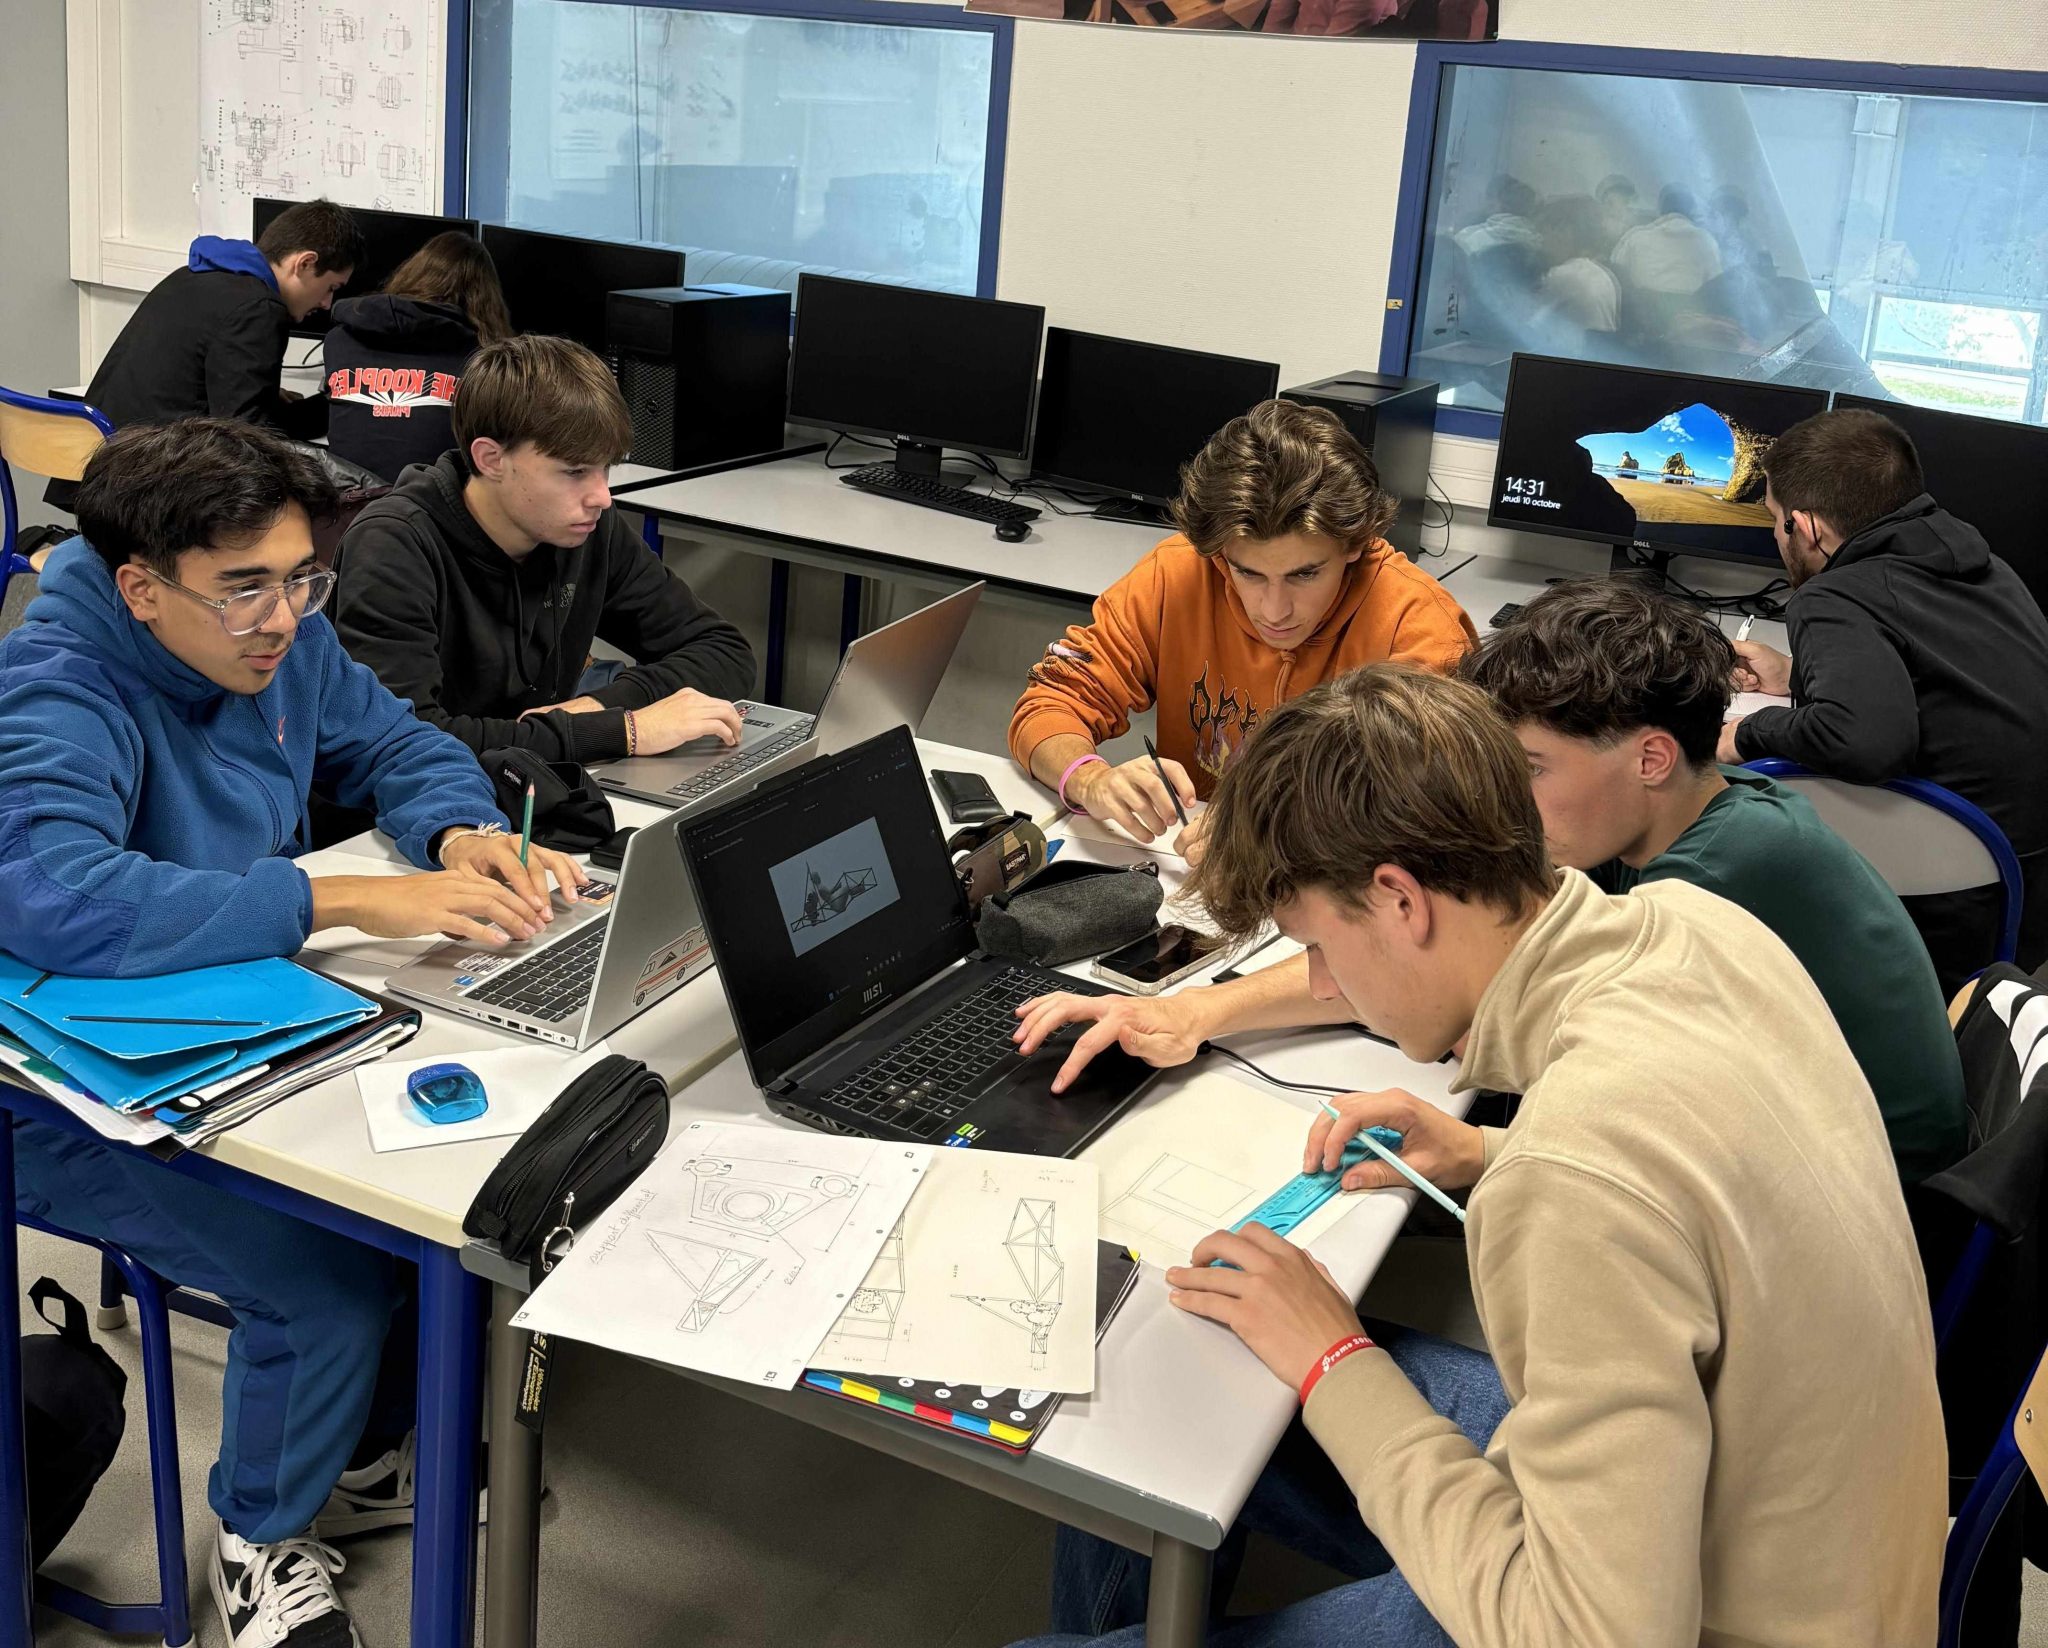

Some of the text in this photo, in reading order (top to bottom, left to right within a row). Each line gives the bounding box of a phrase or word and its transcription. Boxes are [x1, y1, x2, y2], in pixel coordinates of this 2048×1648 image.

[1505, 476, 1545, 497] 14:31
[1501, 493, 1561, 510] jeudi 10 octobre
[1633, 540, 1651, 548] DELL
[1005, 853, 1027, 871] EASTPAK
[863, 981, 883, 1004] MSI
[1321, 1341, 1353, 1372] Promo
